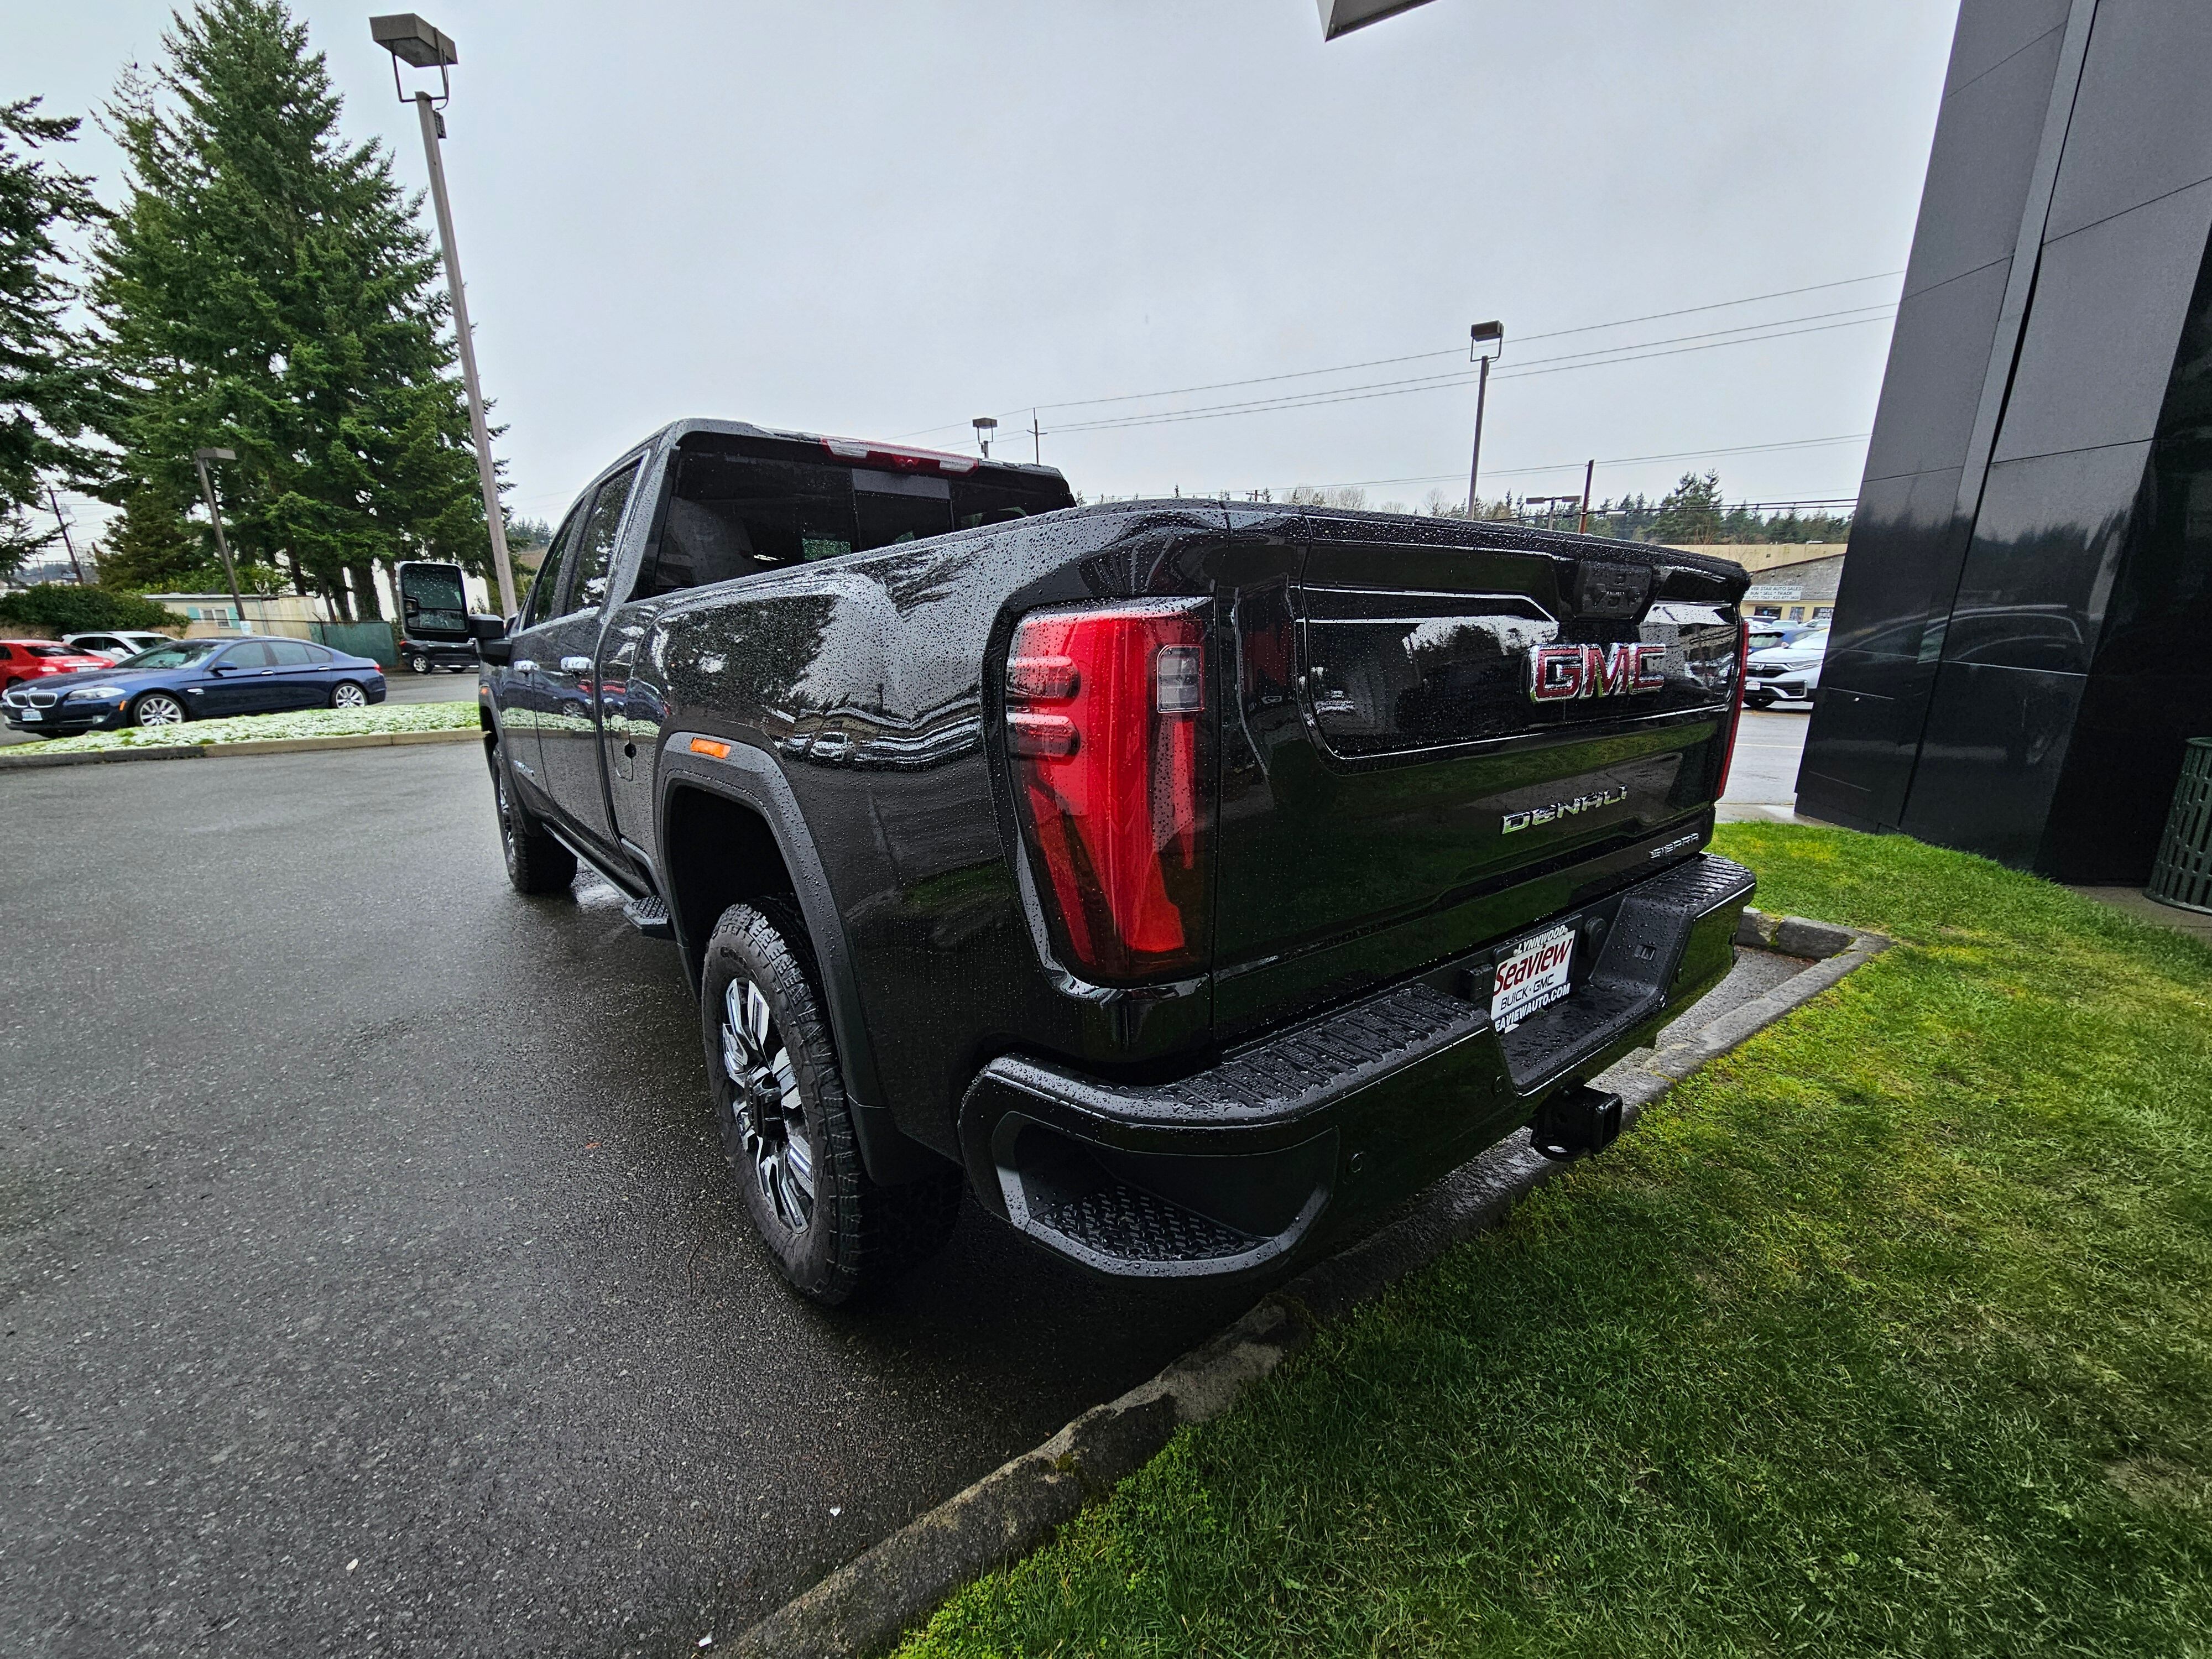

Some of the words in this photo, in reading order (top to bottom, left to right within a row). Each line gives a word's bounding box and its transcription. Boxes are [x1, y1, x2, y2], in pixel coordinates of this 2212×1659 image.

[1530, 643, 1666, 703] GMC
[1501, 784, 1628, 834] DENALI
[1649, 833, 1699, 858] SIERRA
[1517, 924, 1566, 953] LYNNWOOD
[1493, 938, 1573, 996] Seaview
[1500, 985, 1529, 1010] BUICK
[1533, 973, 1554, 993] GMC
[1494, 983, 1571, 1032] EAVIEWAUTO.COM
